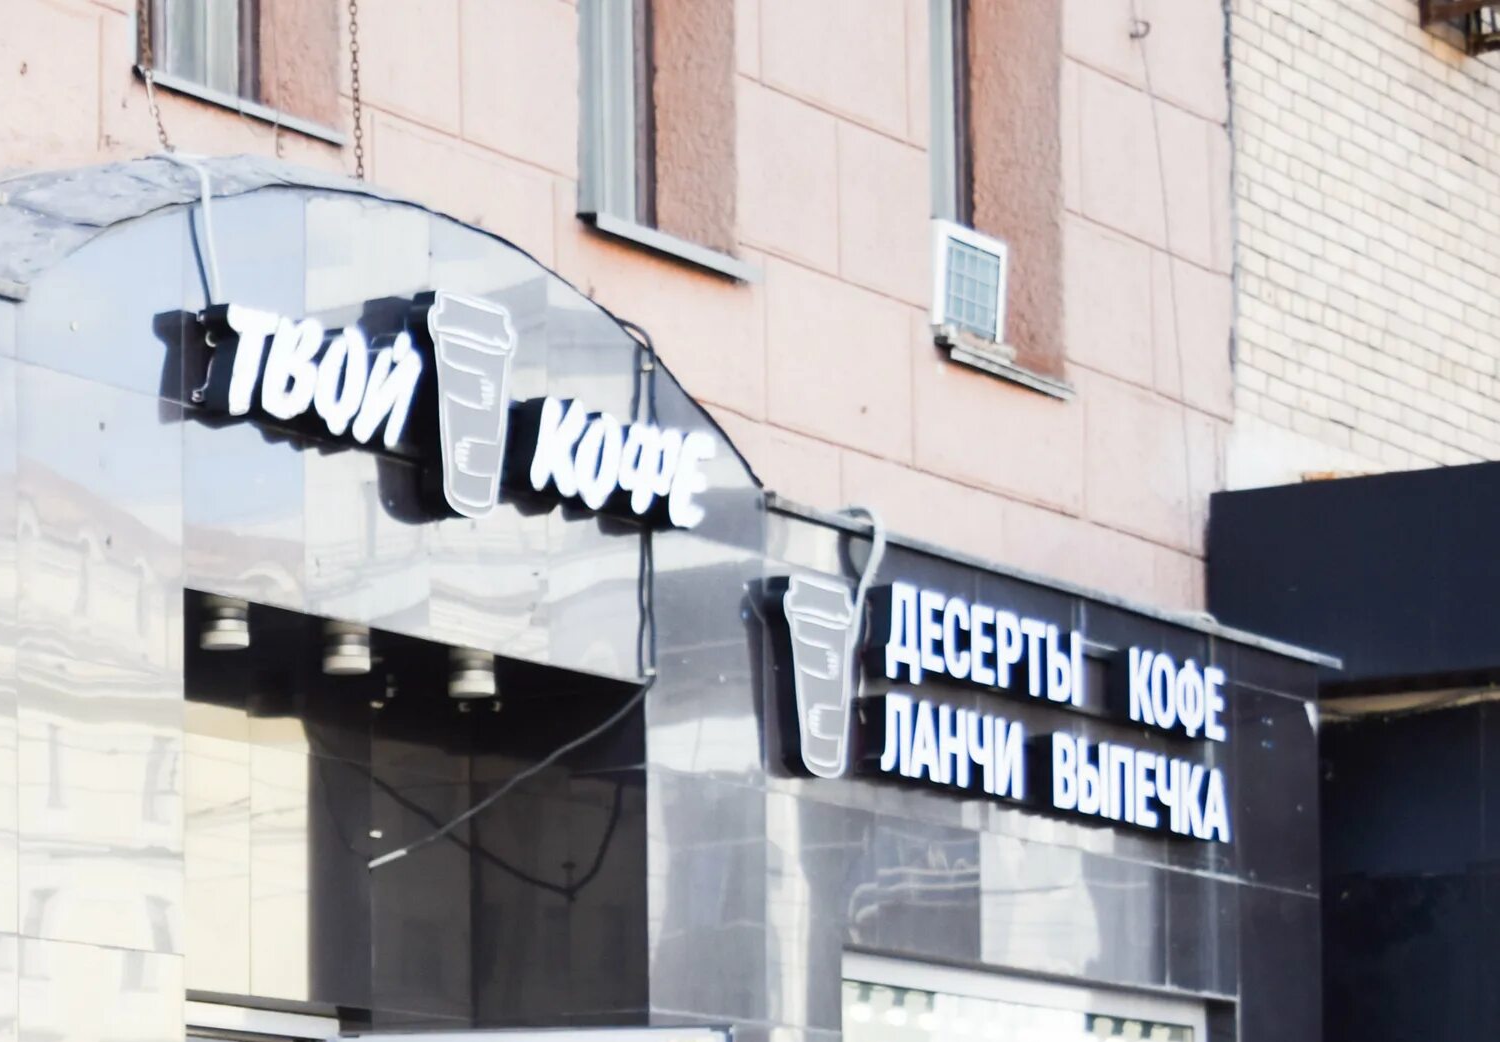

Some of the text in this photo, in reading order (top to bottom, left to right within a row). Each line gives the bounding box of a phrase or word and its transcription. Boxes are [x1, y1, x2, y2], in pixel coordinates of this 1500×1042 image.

[227, 303, 716, 528] ТВОЙ КОФЕ
[885, 581, 1228, 742] ДЕСЕРТЫ КОФЕ
[880, 693, 1230, 843] ЛАНЧИ ВЫПЕЧКА
